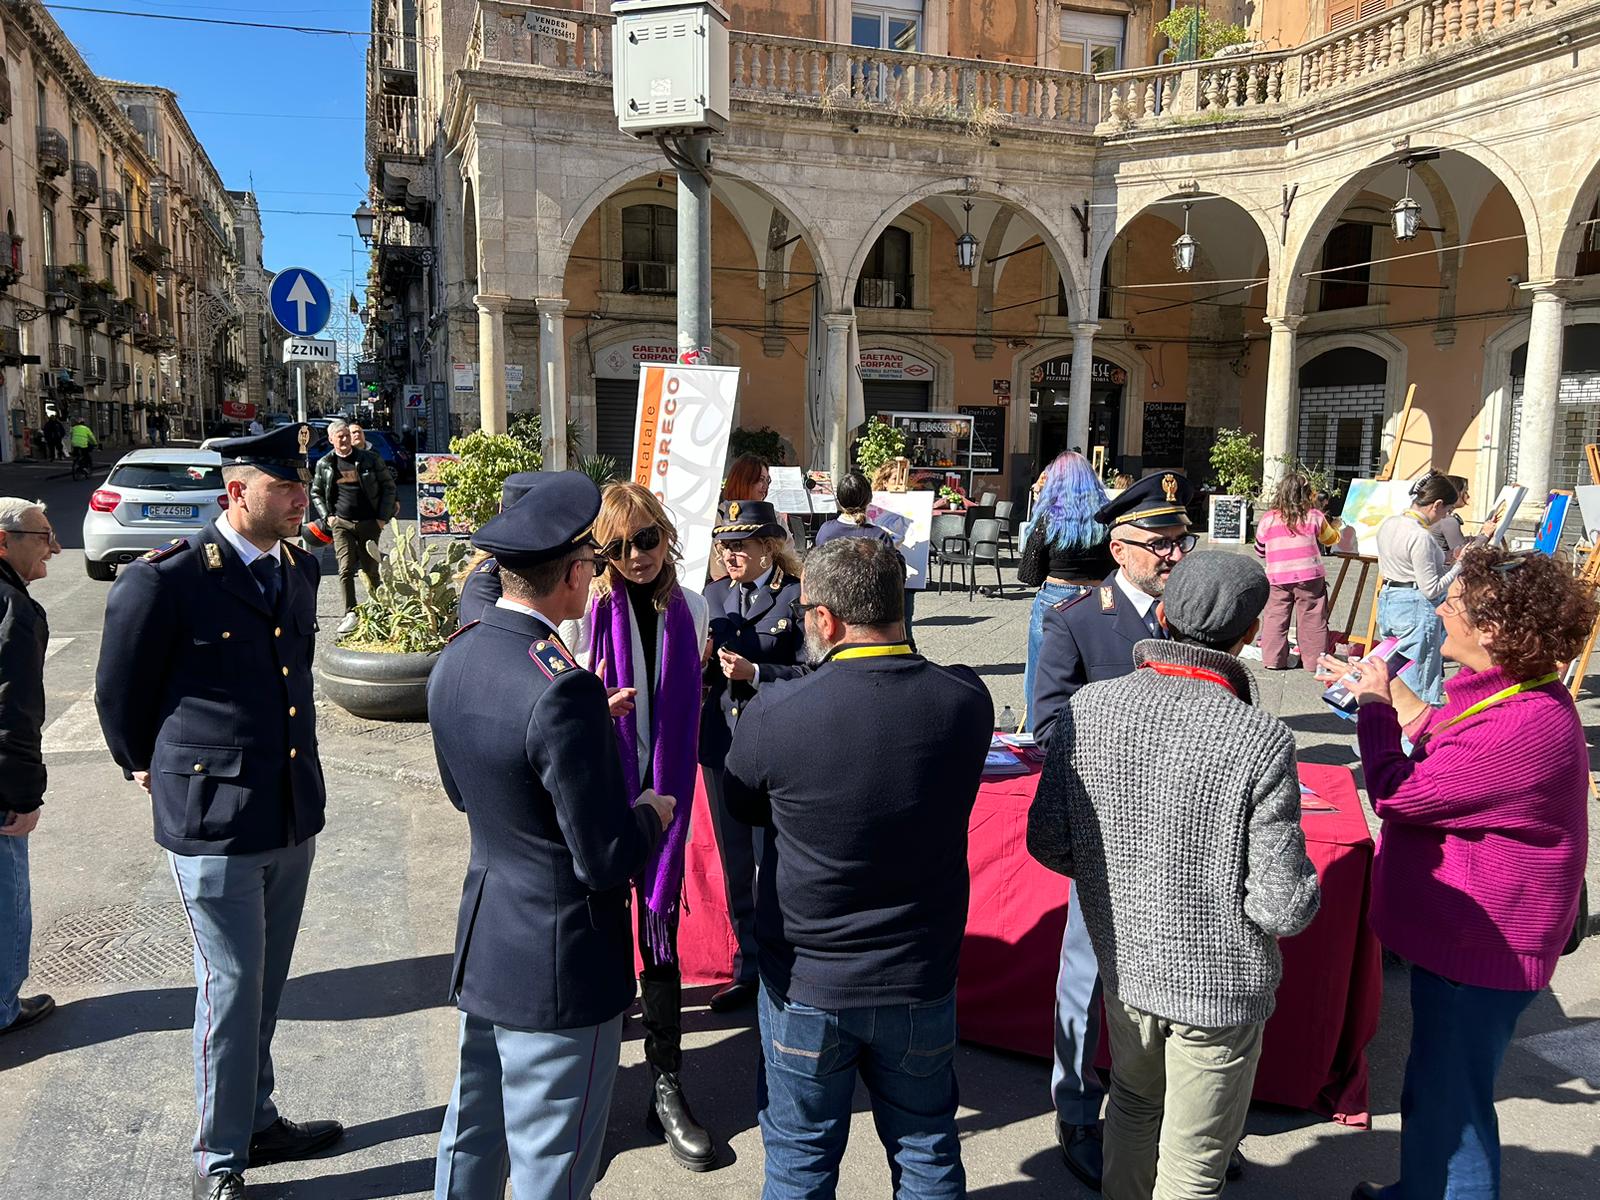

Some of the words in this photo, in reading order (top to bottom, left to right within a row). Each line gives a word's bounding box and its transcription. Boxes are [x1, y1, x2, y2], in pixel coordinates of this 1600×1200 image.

[535, 15, 568, 29] VENDESI
[538, 24, 550, 34] 342
[632, 345, 677, 354] GAETAN
[632, 353, 677, 361] CORPAC
[860, 353, 904, 361] GAETANO
[1046, 362, 1056, 375] IL
[342, 376, 354, 391] P
[657, 377, 680, 477] GRECO
[637, 405, 656, 485] Statale
